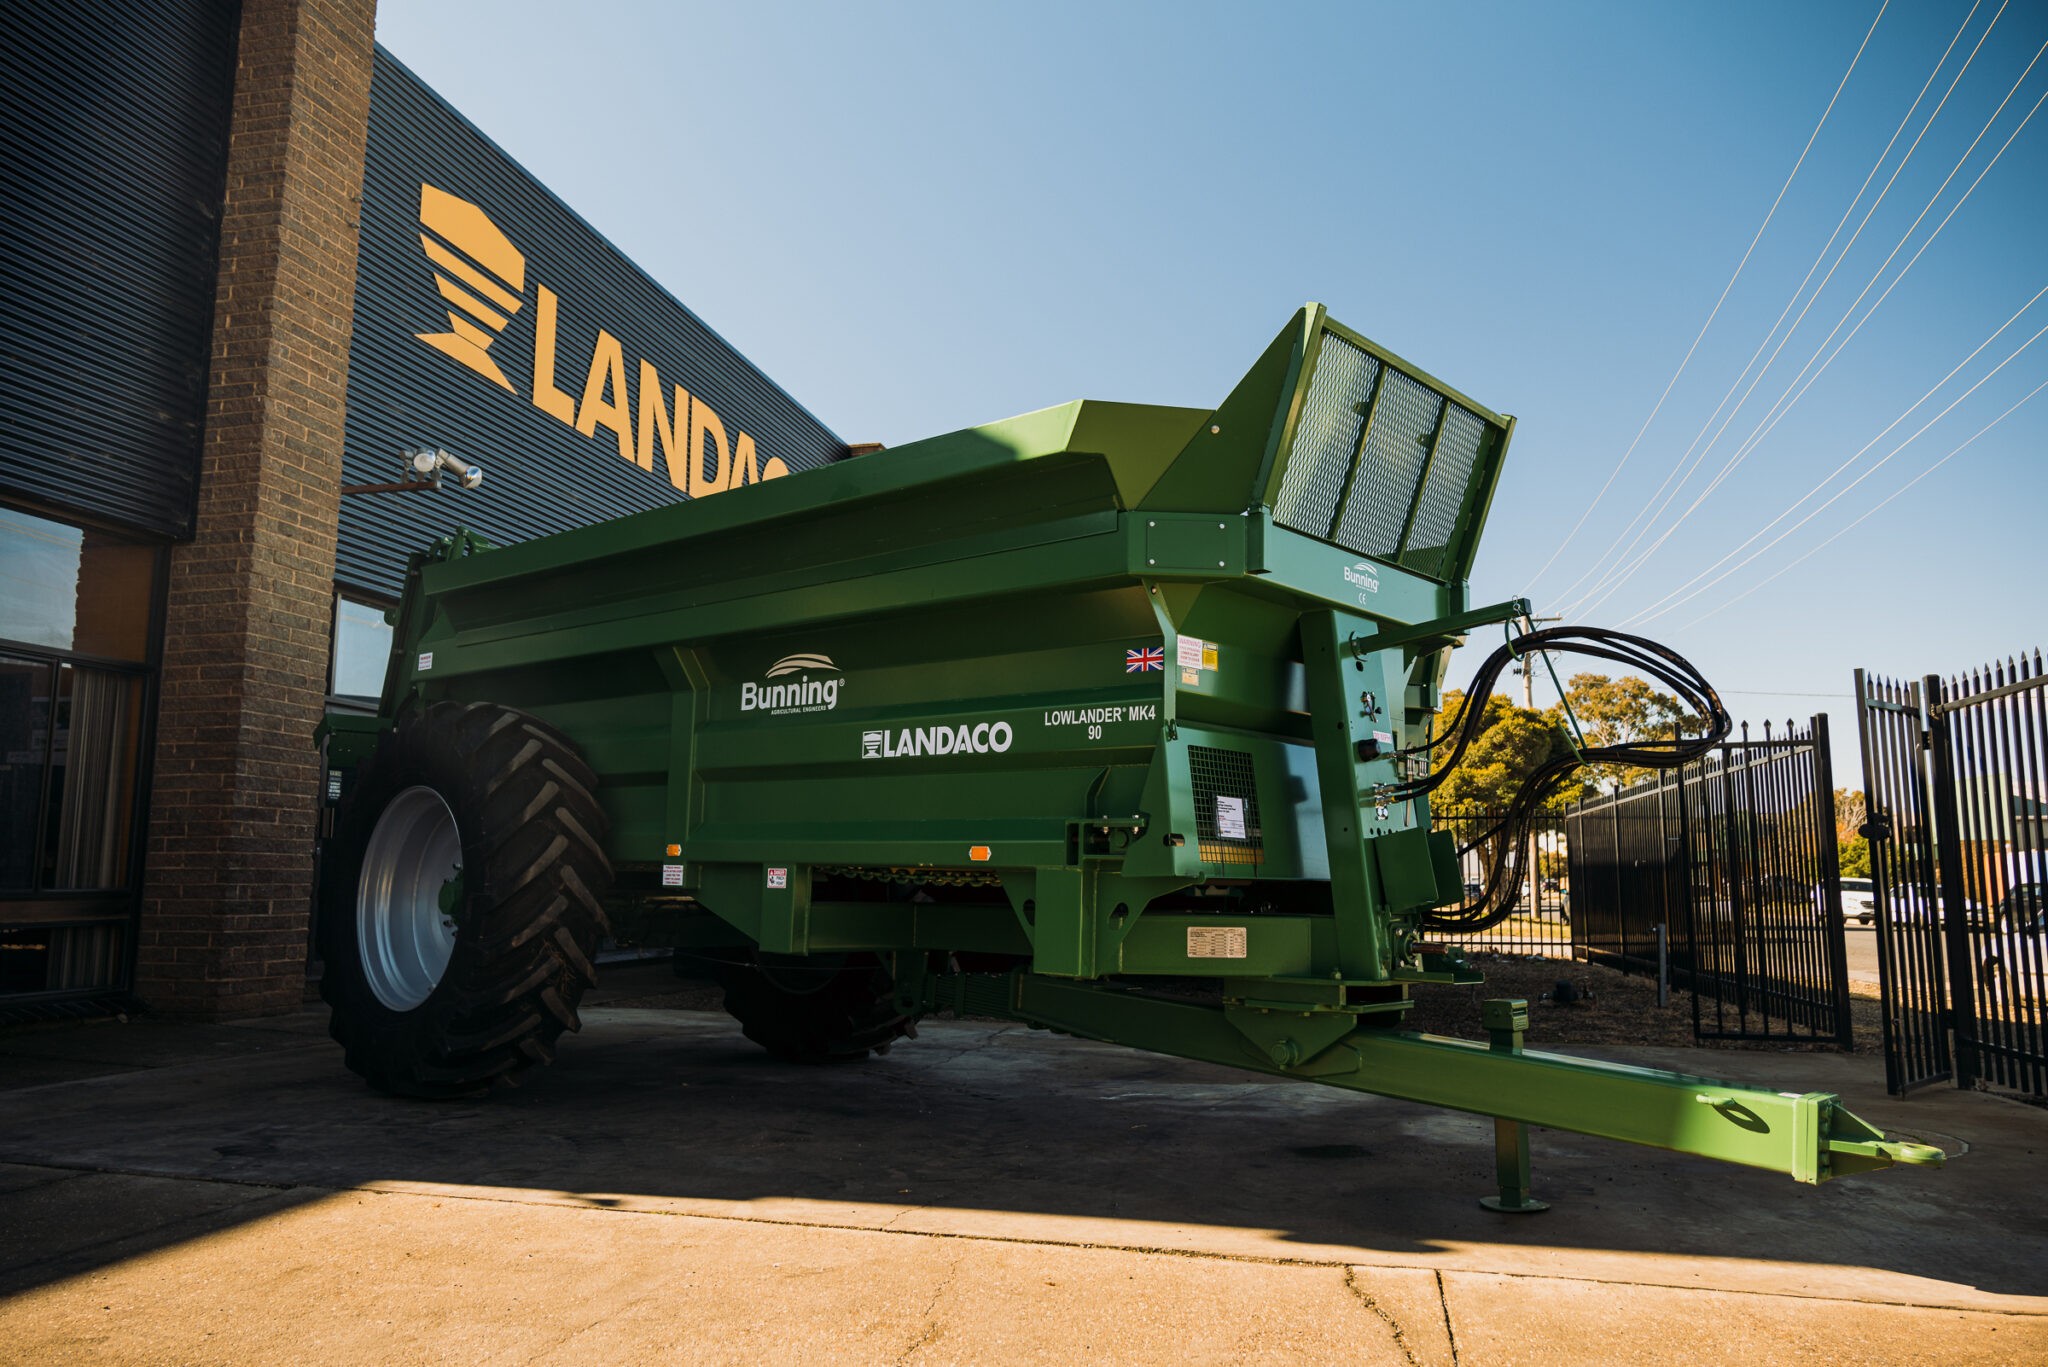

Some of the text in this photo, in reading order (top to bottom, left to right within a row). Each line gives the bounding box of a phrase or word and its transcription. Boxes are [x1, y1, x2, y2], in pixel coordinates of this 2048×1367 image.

[532, 282, 790, 499] LANDA
[770, 704, 827, 716] AGRICULTURAL ENGINEERS
[1128, 704, 1157, 721] MK4
[883, 721, 1013, 758] LANDACO
[1087, 724, 1102, 740] 90
